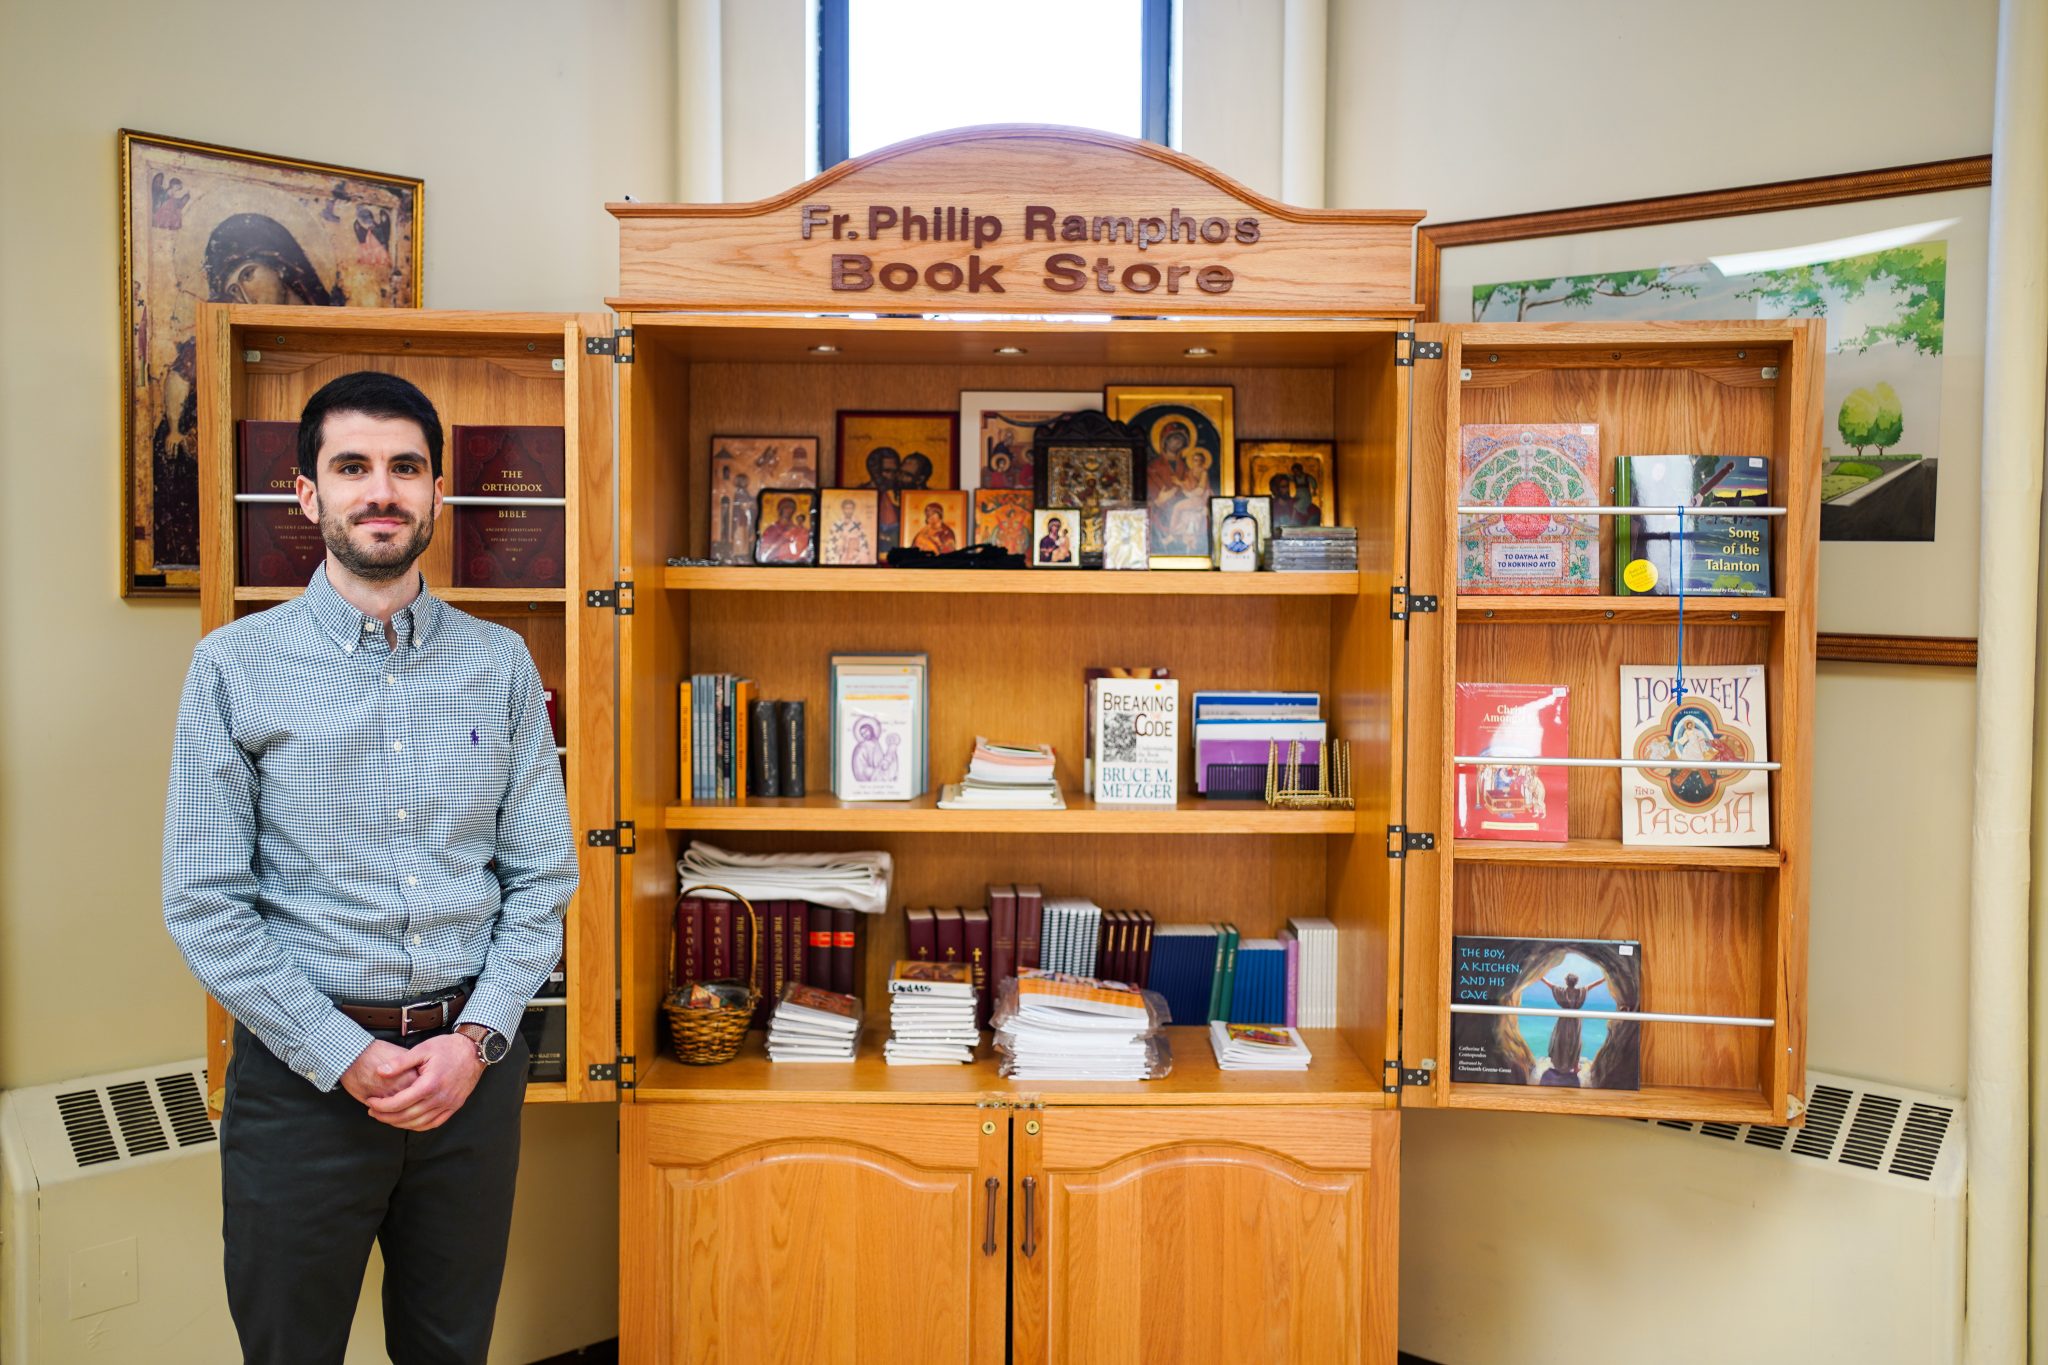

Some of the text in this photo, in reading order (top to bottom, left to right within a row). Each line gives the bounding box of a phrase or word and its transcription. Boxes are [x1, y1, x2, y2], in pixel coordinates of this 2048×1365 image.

[801, 204, 1261, 250] Fr. Philip Ramphos
[831, 253, 1234, 294] Book Store
[501, 470, 523, 479] THE
[482, 483, 543, 492] ORTHODOX
[498, 510, 527, 519] BIBLE
[1728, 526, 1760, 542] Song
[1722, 543, 1760, 555] of the
[1705, 559, 1760, 572] Talanton
[1103, 692, 1174, 712] BREAKING
[1690, 677, 1753, 727] WEEK
[1135, 713, 1173, 736] CODE
[1102, 767, 1173, 783] BRUCE M.
[1101, 783, 1172, 799] METZGER
[1633, 791, 1756, 836] PASCHA
[1460, 947, 1505, 959] THE BOY,
[1460, 961, 1524, 976] A KITCHEN,
[1460, 975, 1505, 987] AND HIS
[1460, 989, 1488, 1000] CAVE
